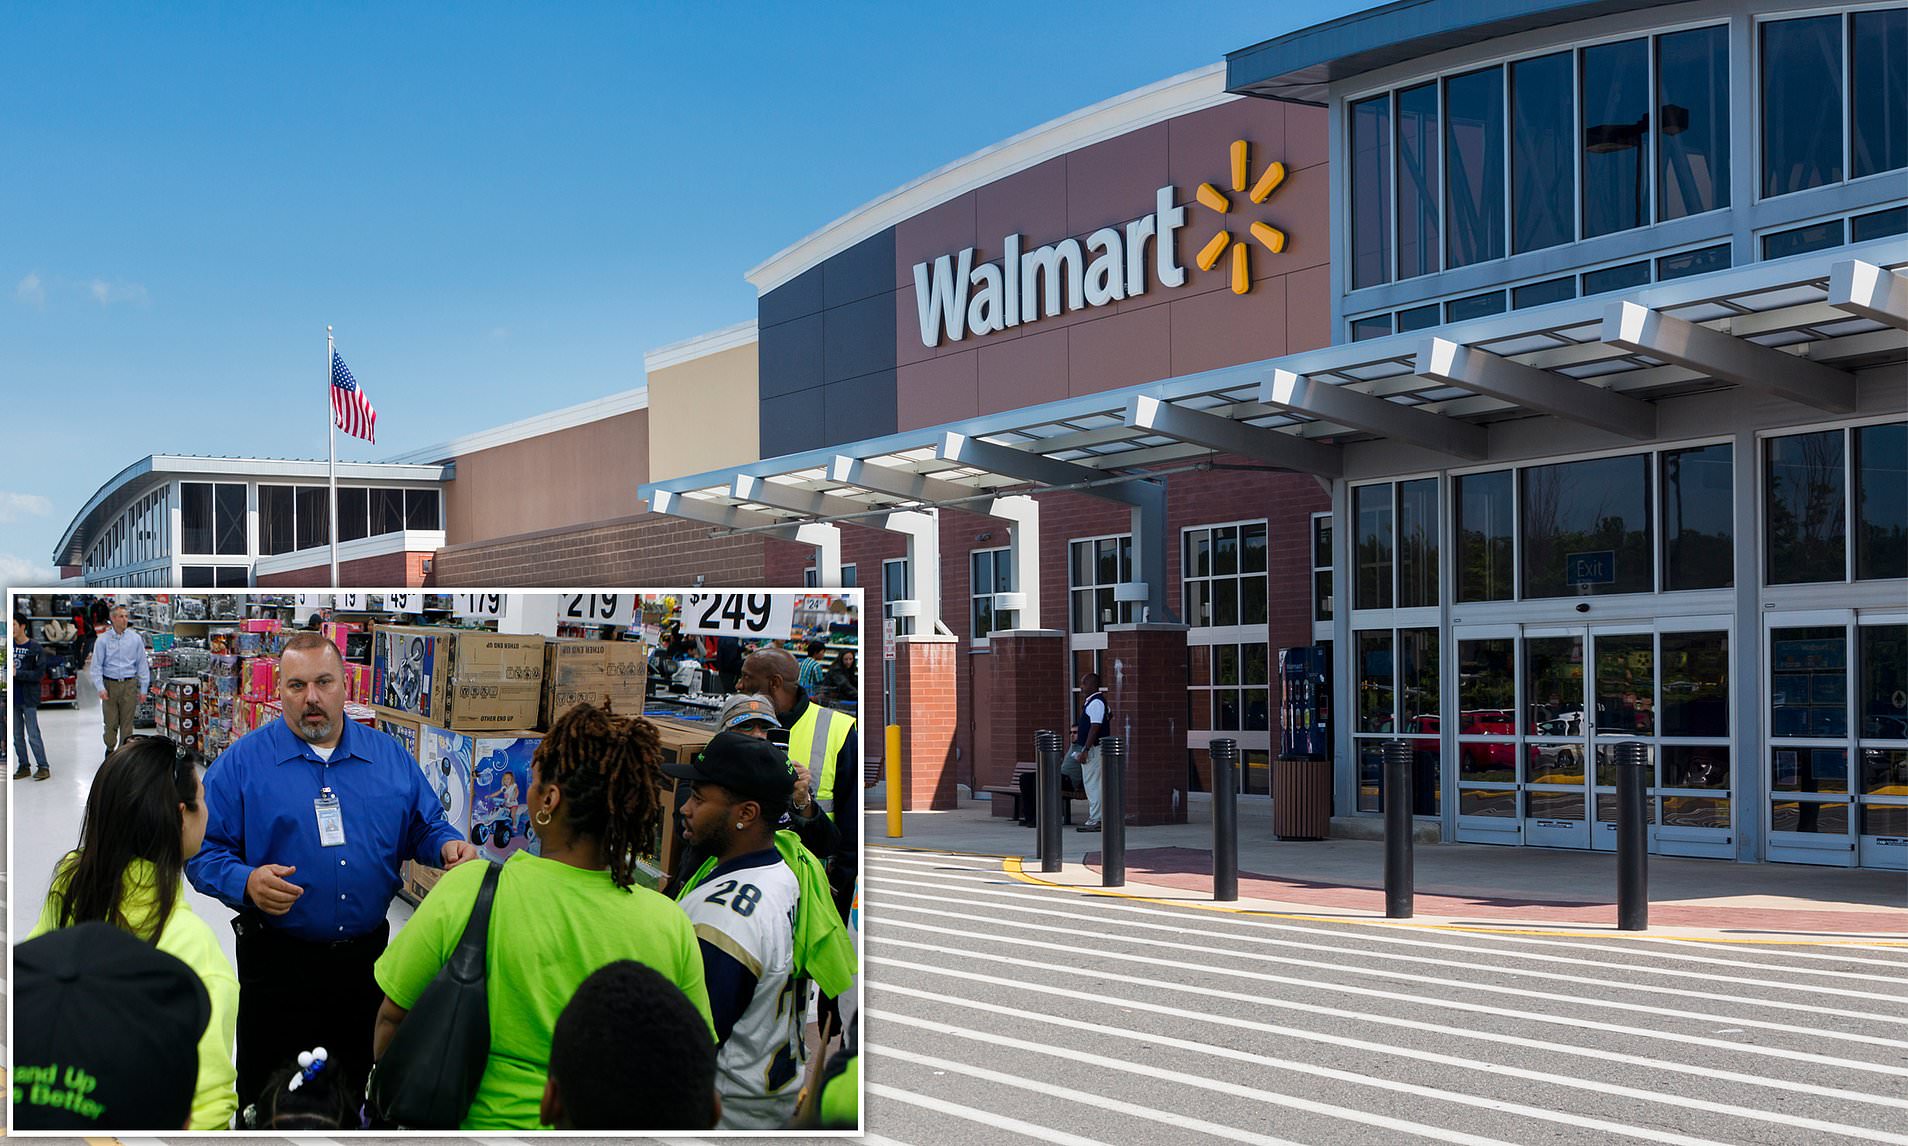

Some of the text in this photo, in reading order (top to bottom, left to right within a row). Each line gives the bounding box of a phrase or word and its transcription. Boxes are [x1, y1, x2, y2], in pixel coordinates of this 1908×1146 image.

[912, 185, 1186, 348] Walmart
[1577, 560, 1603, 577] Exit
[704, 879, 762, 917] 28
[64, 1065, 97, 1097] Up
